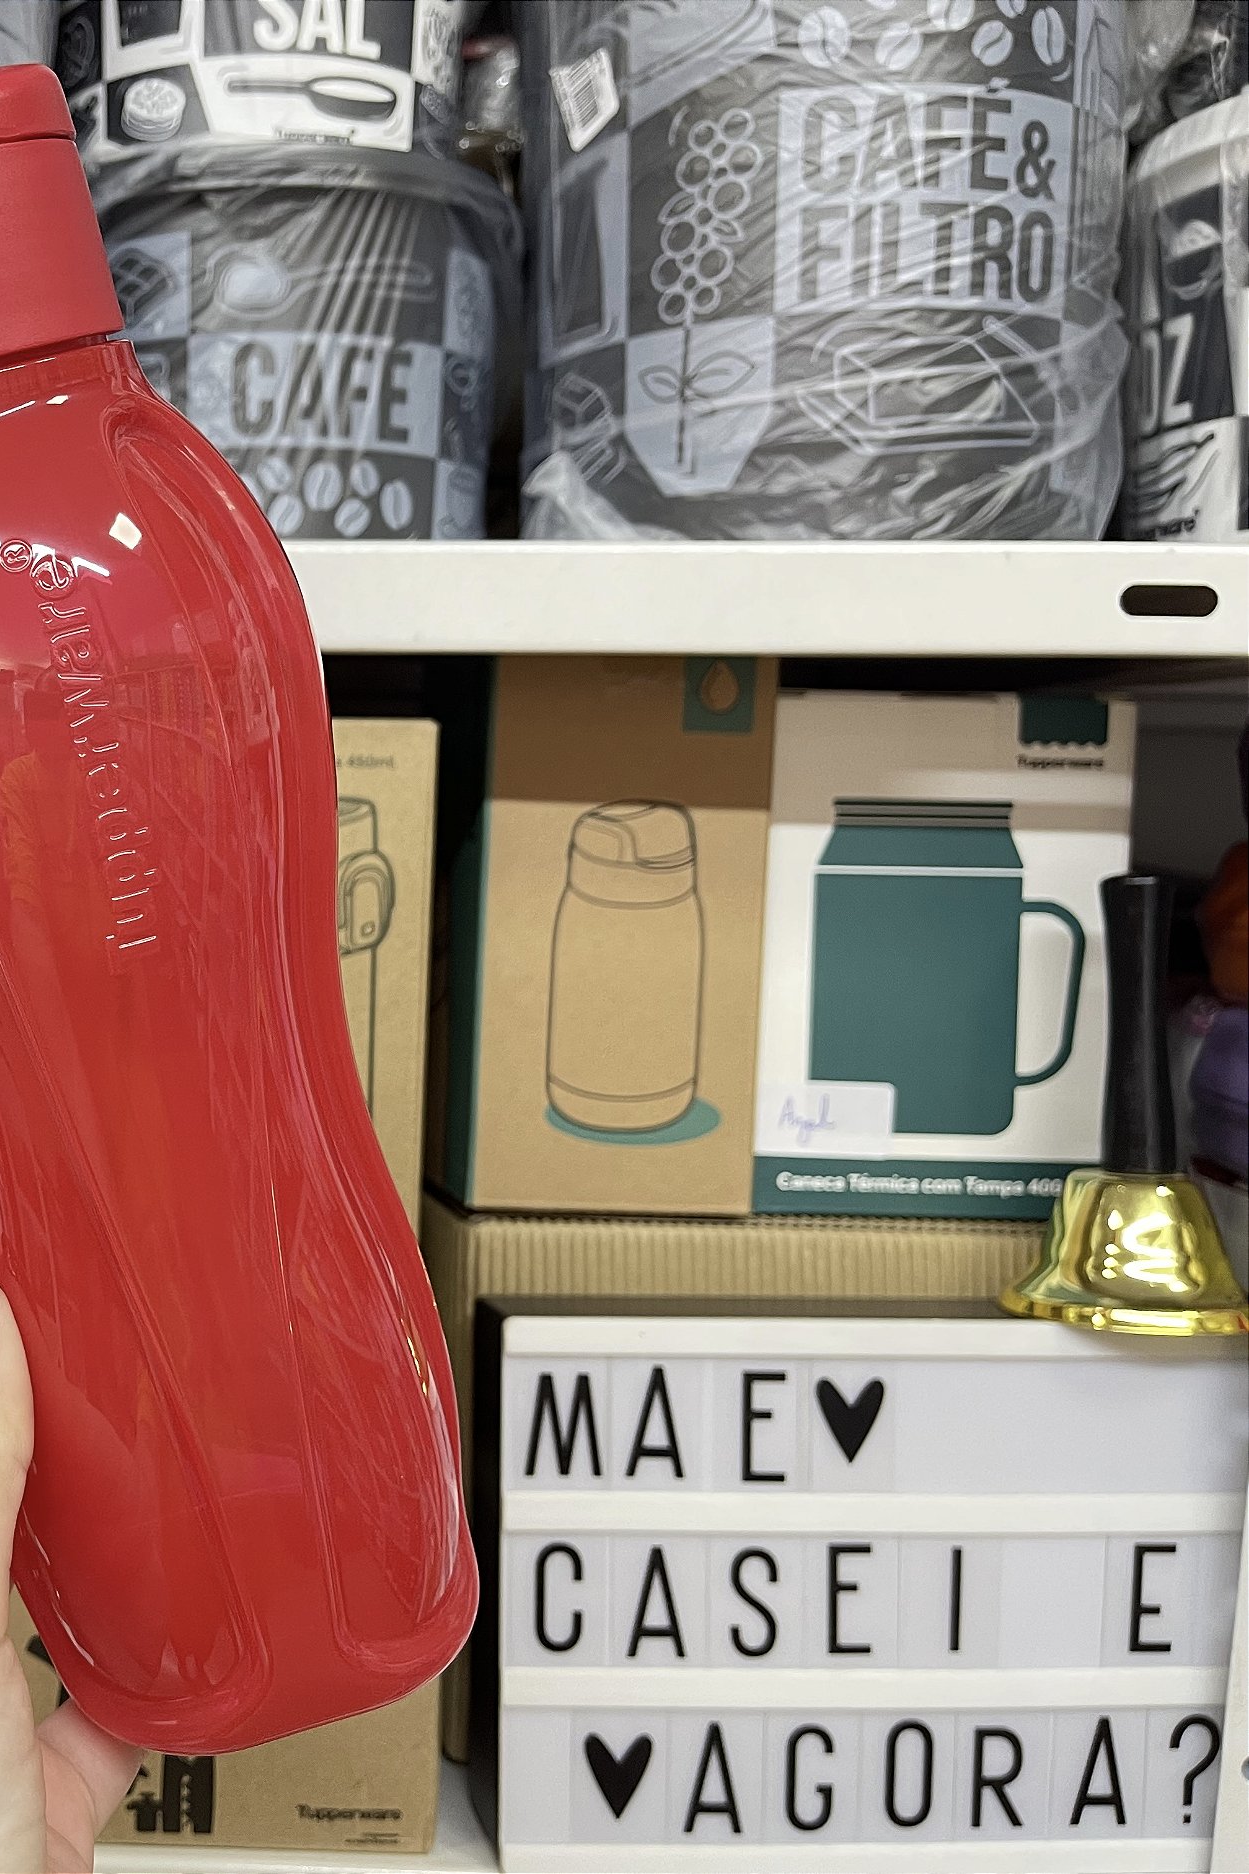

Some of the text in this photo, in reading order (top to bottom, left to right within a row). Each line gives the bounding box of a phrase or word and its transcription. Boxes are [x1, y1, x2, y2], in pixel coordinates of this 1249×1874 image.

[799, 202, 1054, 303] FILTRO
[921, 1177, 963, 1196] com
[964, 1174, 1025, 1199] Tampa
[524, 1364, 788, 1483] MAE
[534, 1542, 1178, 1660] CASEI E
[294, 1803, 404, 1823] Tupperware
[683, 1713, 1221, 1835] AGORA?
